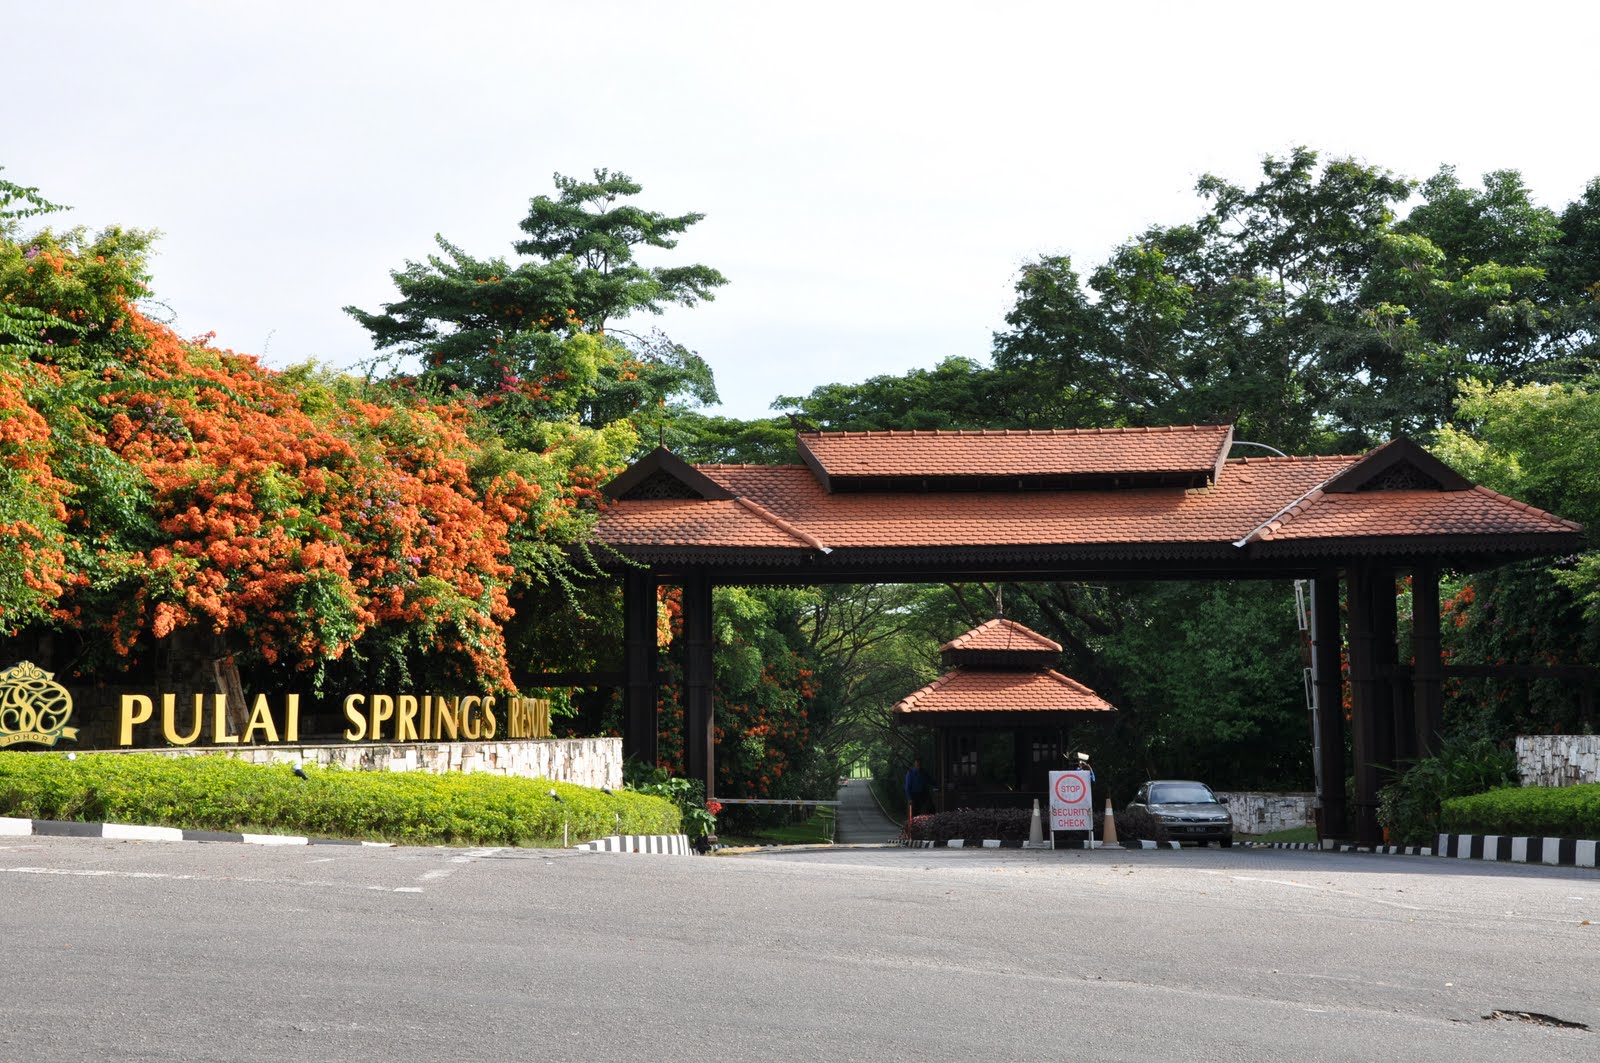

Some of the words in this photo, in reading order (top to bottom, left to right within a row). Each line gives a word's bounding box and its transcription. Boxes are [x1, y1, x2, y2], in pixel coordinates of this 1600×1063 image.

[119, 693, 300, 746] PULAI
[343, 693, 497, 742] SPRINGS
[507, 697, 551, 738] RESORT
[7, 735, 48, 743] JOHOR
[1060, 785, 1081, 793] STOP
[1052, 808, 1090, 817] SECURITY
[1058, 819, 1086, 827] CHECK
